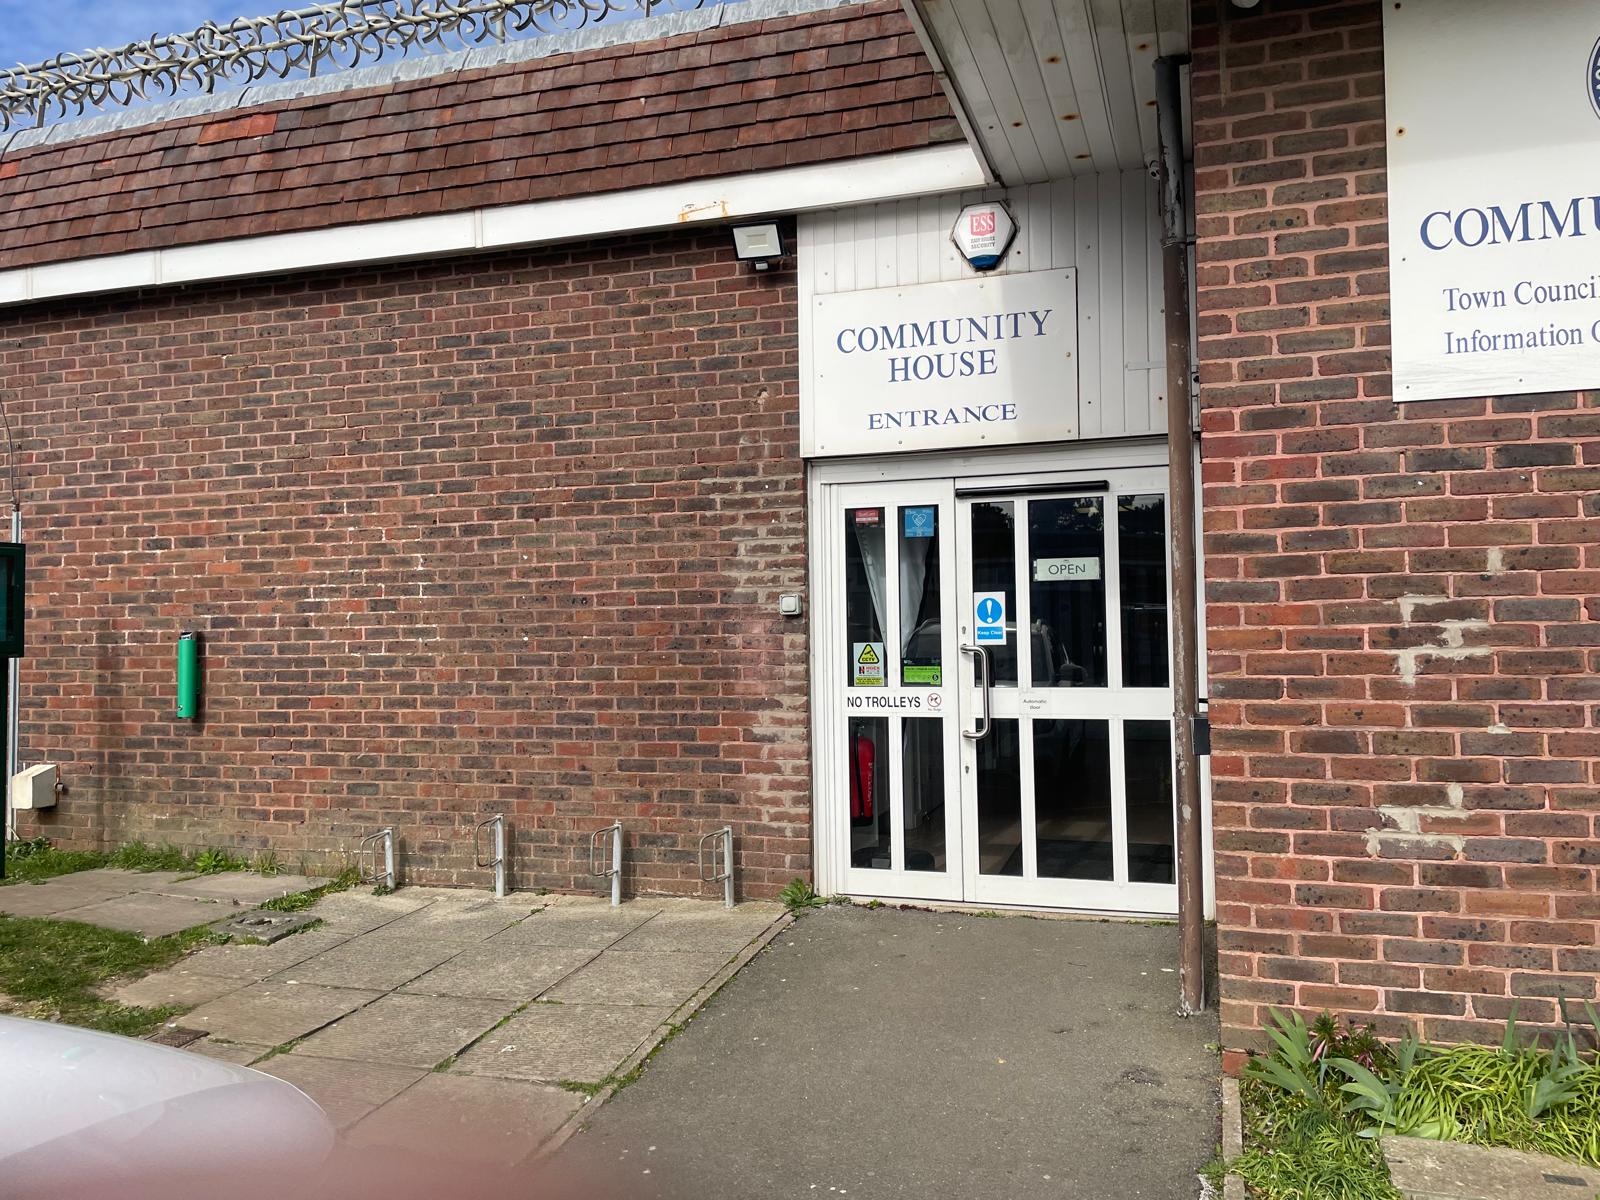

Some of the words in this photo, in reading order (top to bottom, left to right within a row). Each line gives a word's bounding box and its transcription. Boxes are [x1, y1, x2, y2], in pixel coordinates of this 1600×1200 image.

[972, 214, 993, 232] ESS
[1442, 287, 1506, 312] Town
[1514, 275, 1600, 305] Counci
[837, 309, 1052, 353] COMMUNITY
[1444, 323, 1584, 354] Information
[888, 348, 998, 382] HOUSE
[868, 403, 1018, 430] ENTRANCE
[1048, 563, 1086, 575] OPEN
[847, 696, 862, 708] NO
[865, 696, 921, 708] TROLLEYS
